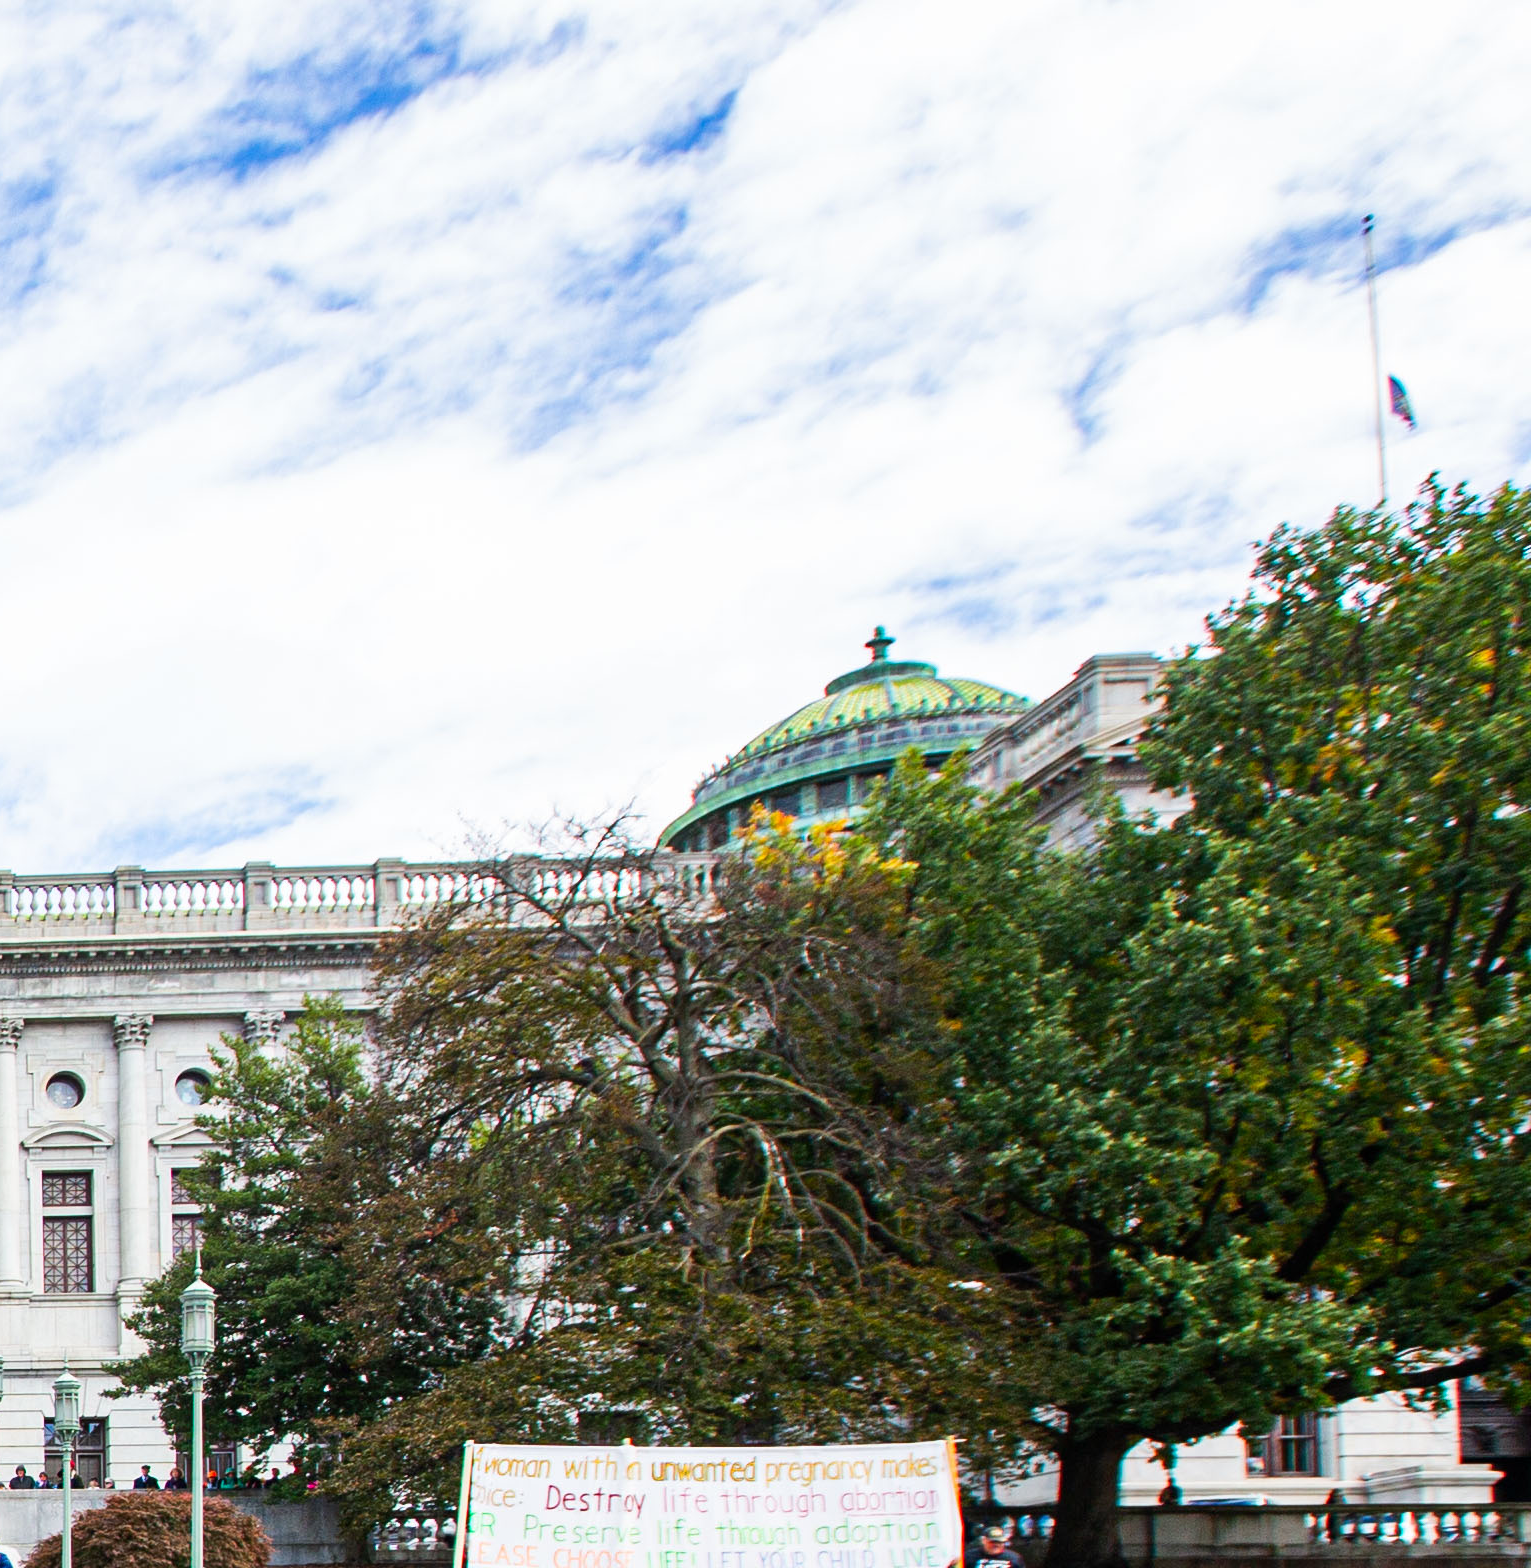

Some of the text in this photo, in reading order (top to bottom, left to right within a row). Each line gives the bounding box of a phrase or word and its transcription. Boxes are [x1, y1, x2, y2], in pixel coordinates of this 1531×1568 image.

[484, 1458, 550, 1478] woman
[564, 1453, 618, 1480] with
[651, 1456, 756, 1482] unwanted
[765, 1459, 873, 1487] pregnancy
[881, 1452, 936, 1477] makes
[545, 1484, 646, 1518] Destroy
[663, 1485, 708, 1513] life
[720, 1487, 826, 1518] through
[524, 1513, 641, 1544] Preserve
[657, 1518, 700, 1544] life
[715, 1518, 801, 1547] through
[814, 1516, 939, 1548] adoption
